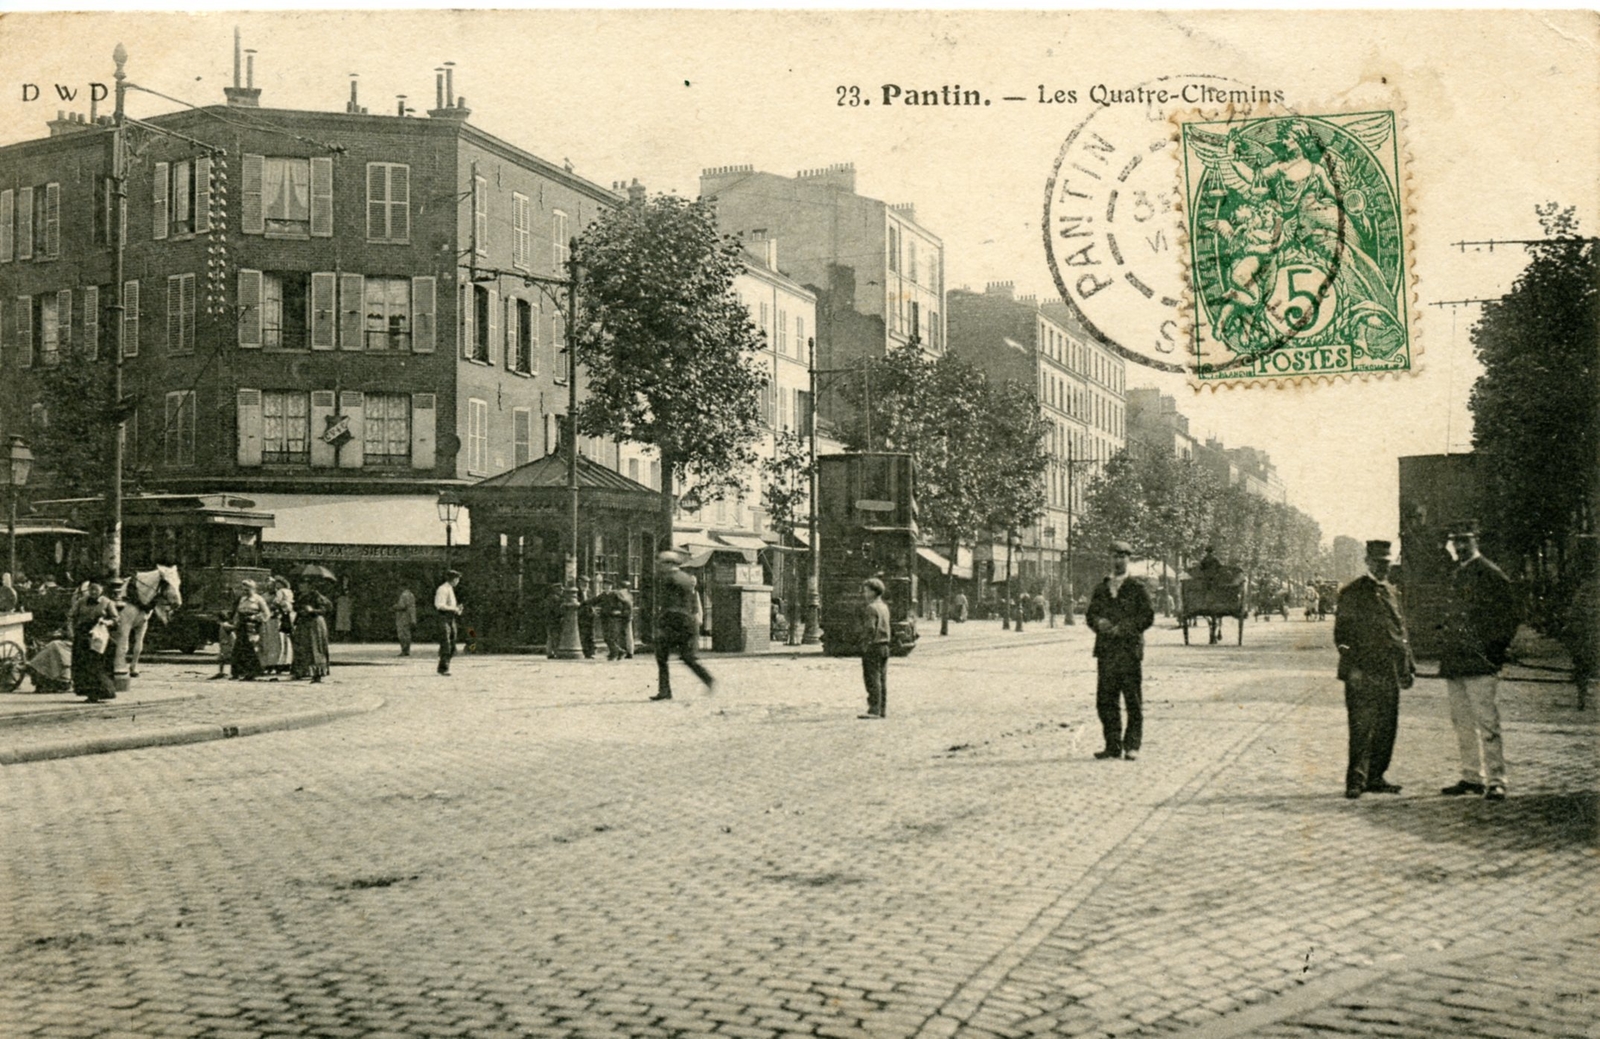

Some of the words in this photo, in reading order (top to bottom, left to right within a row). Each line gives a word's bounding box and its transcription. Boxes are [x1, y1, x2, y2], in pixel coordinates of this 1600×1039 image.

[1059, 132, 1116, 300] PANTIN
[1285, 268, 1321, 330] 5
[1256, 346, 1350, 374] POSTES
